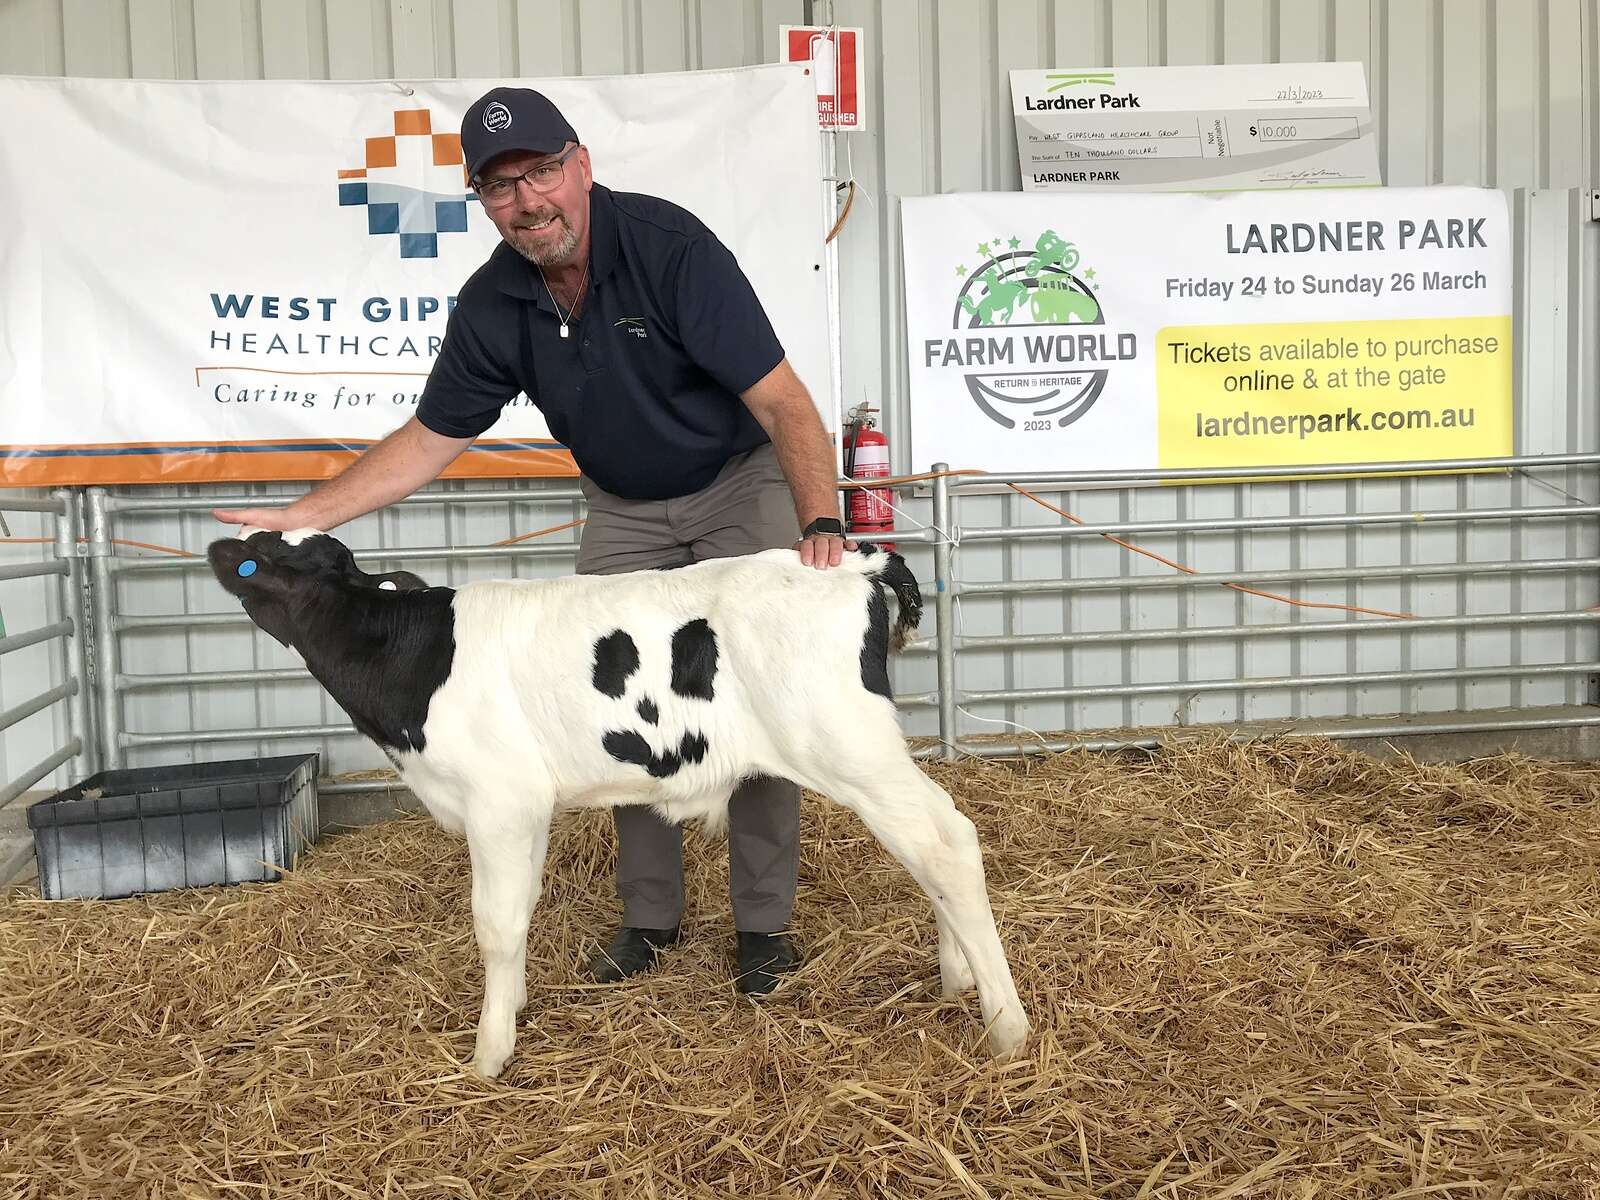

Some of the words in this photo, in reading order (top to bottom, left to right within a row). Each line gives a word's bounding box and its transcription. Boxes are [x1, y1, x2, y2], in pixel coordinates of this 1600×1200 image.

[1025, 95, 1096, 111] Lardner
[1099, 93, 1141, 108] Park
[818, 113, 855, 123] GUISHER
[1250, 126, 1257, 137] $
[1215, 119, 1225, 157] Negotiable
[1033, 172, 1087, 183] LARDNER
[1090, 171, 1120, 181] PARK
[1226, 221, 1385, 254] LARDNER
[1399, 218, 1488, 250] PARK
[1166, 275, 1234, 301] Friday
[1240, 276, 1267, 296] 24
[1274, 276, 1295, 295] to
[1302, 273, 1384, 297] Sunday
[1390, 272, 1415, 292] 26
[1422, 270, 1487, 291] March
[210, 293, 337, 322] WEST
[210, 330, 442, 357] HEALTHCAR
[925, 337, 1014, 367] FARM
[1024, 333, 1137, 364] WORLD
[1168, 341, 1251, 364] Tickets
[1259, 337, 1359, 362] available
[1367, 338, 1388, 358] to
[1395, 333, 1498, 362] purchase
[994, 379, 1030, 388] RETURN
[1039, 377, 1082, 386] HERITAGE
[1224, 370, 1294, 392] online
[1302, 369, 1318, 389] &
[1327, 367, 1348, 388] at
[1355, 366, 1391, 387] the
[1398, 365, 1446, 391] gate
[214, 384, 317, 408] Caring
[334, 386, 376, 410] for
[392, 392, 423, 405] ou
[1024, 420, 1052, 431] 2023
[1196, 407, 1475, 439] lardnerpark.com.au
